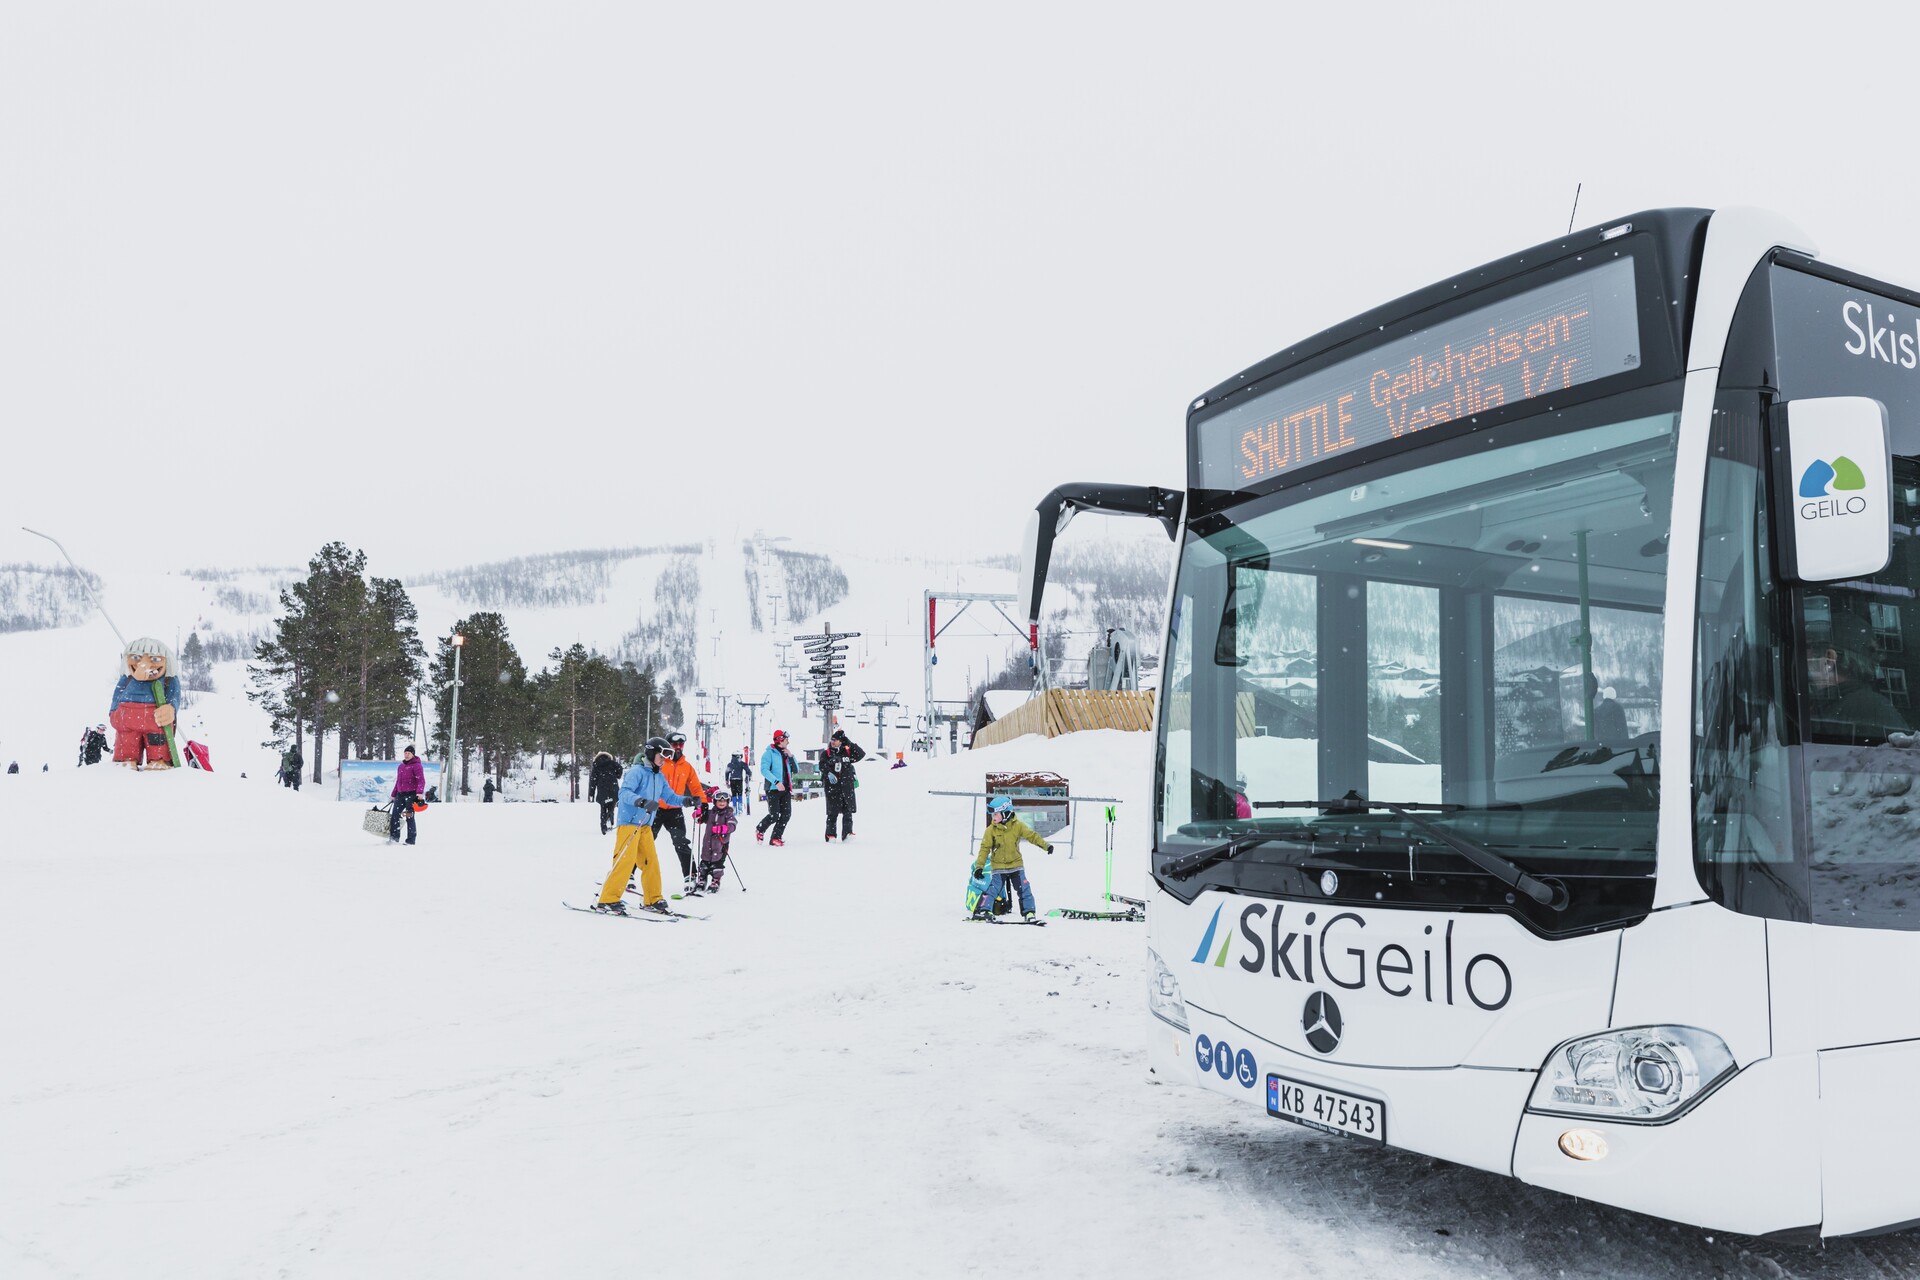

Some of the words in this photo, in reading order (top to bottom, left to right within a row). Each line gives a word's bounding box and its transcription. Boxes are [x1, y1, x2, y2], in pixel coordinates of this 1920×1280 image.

[1369, 310, 1589, 407] Geiloheisen-
[1241, 393, 1355, 479] SHUTTLE
[1800, 496, 1866, 520] GEILO
[1239, 902, 1512, 1011] SkiGeilo
[1271, 1097, 1277, 1106] N
[1282, 1084, 1304, 1113] KB
[1313, 1093, 1375, 1133] 47543
